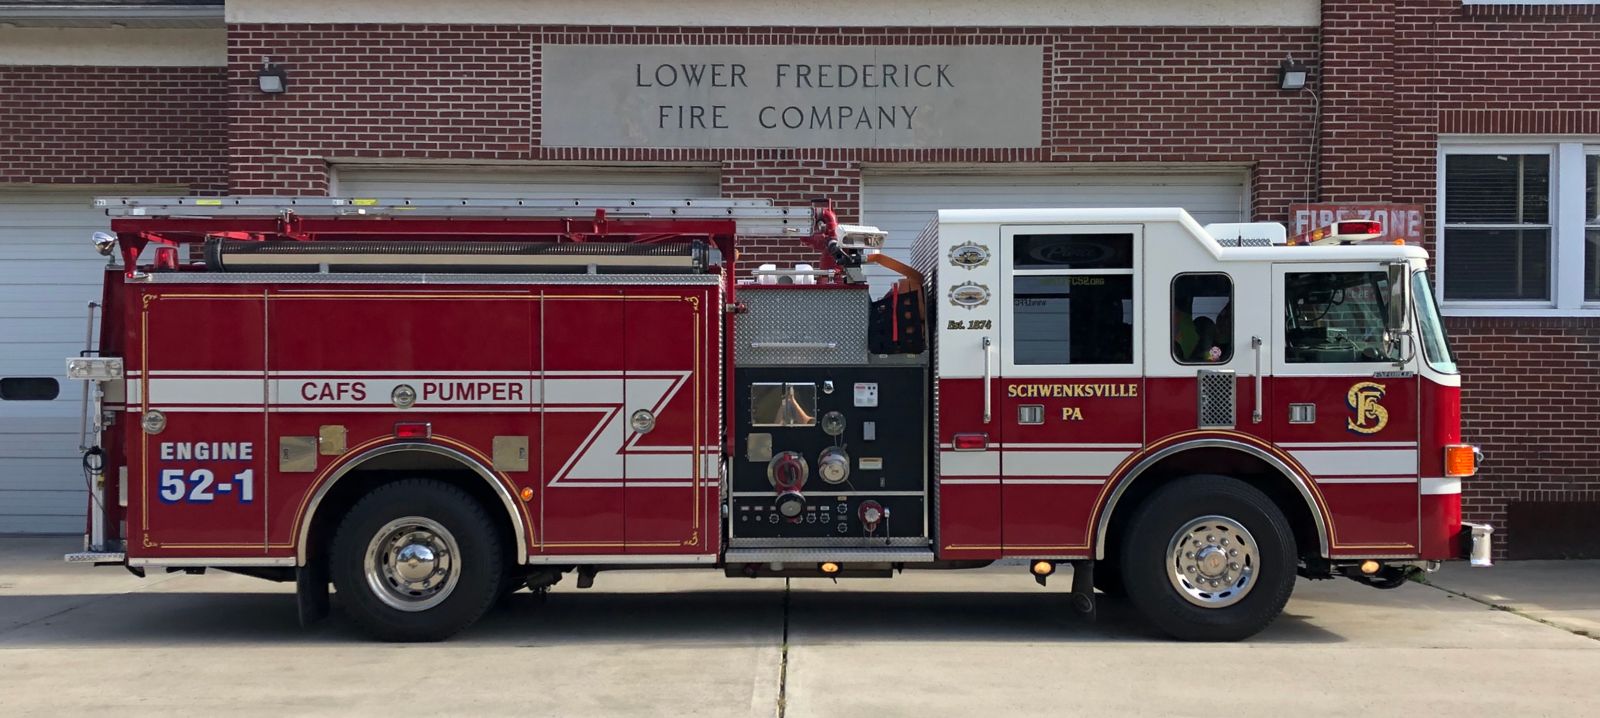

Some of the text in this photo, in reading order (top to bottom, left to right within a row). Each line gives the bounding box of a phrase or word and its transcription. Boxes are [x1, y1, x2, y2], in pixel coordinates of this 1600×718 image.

[636, 64, 955, 88] LOWER FREDERICK
[658, 105, 918, 130] FIRE COMPANY
[967, 320, 992, 330] 1874
[301, 382, 523, 401] CAFS PUMPER
[1008, 384, 1138, 398] SCHWENKSVILLE
[1062, 407, 1084, 421] PA
[160, 442, 253, 460] ENGINE
[158, 468, 254, 504] 52-1
